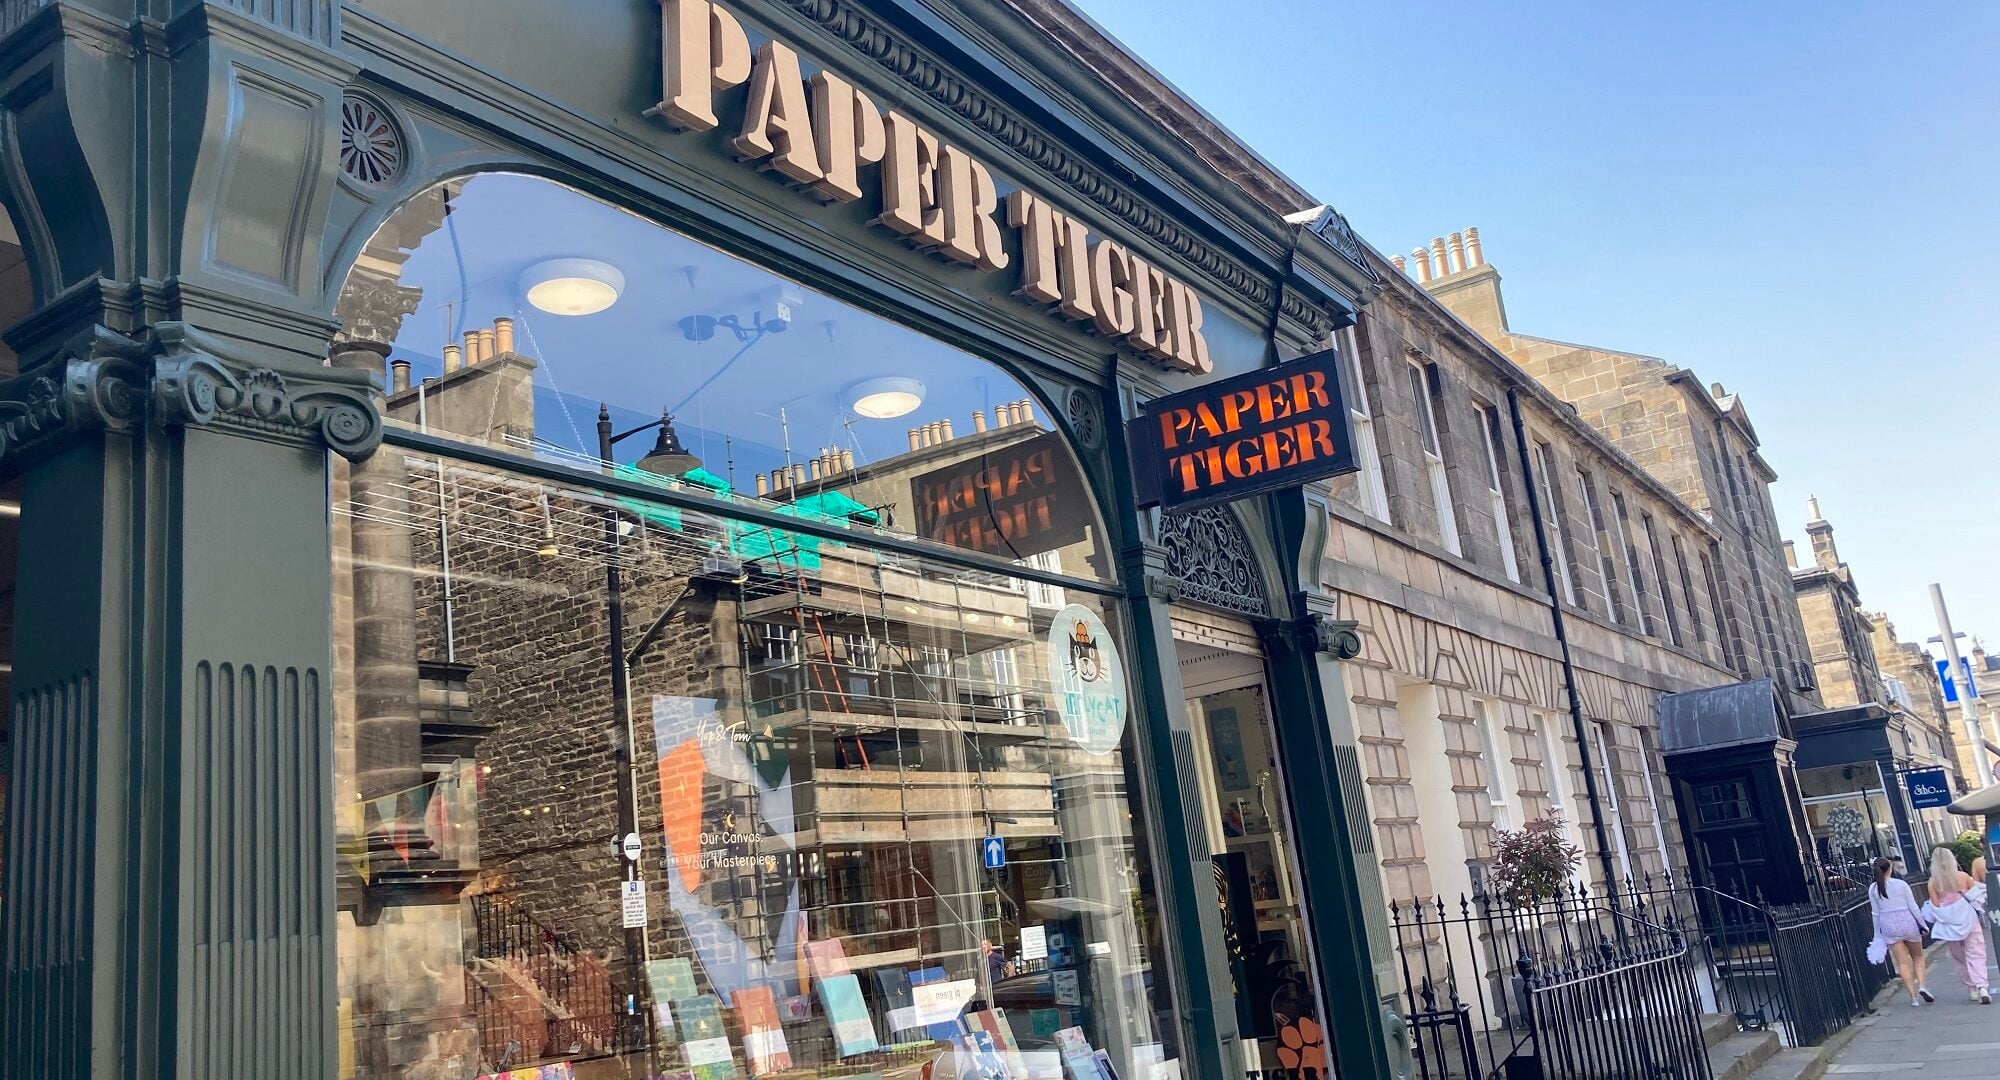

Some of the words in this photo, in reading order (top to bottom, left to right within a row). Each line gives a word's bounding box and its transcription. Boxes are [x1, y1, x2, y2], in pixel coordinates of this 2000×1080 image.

[650, 0, 1009, 271] PAPER
[1008, 190, 1213, 375] TIGER
[1158, 370, 1330, 449] PAPER
[1169, 419, 1335, 493] TIGER
[686, 857, 711, 870] Your
[714, 854, 780, 869] Masterpiece.
[700, 832, 719, 845] Our
[722, 831, 764, 844] Canvas.
